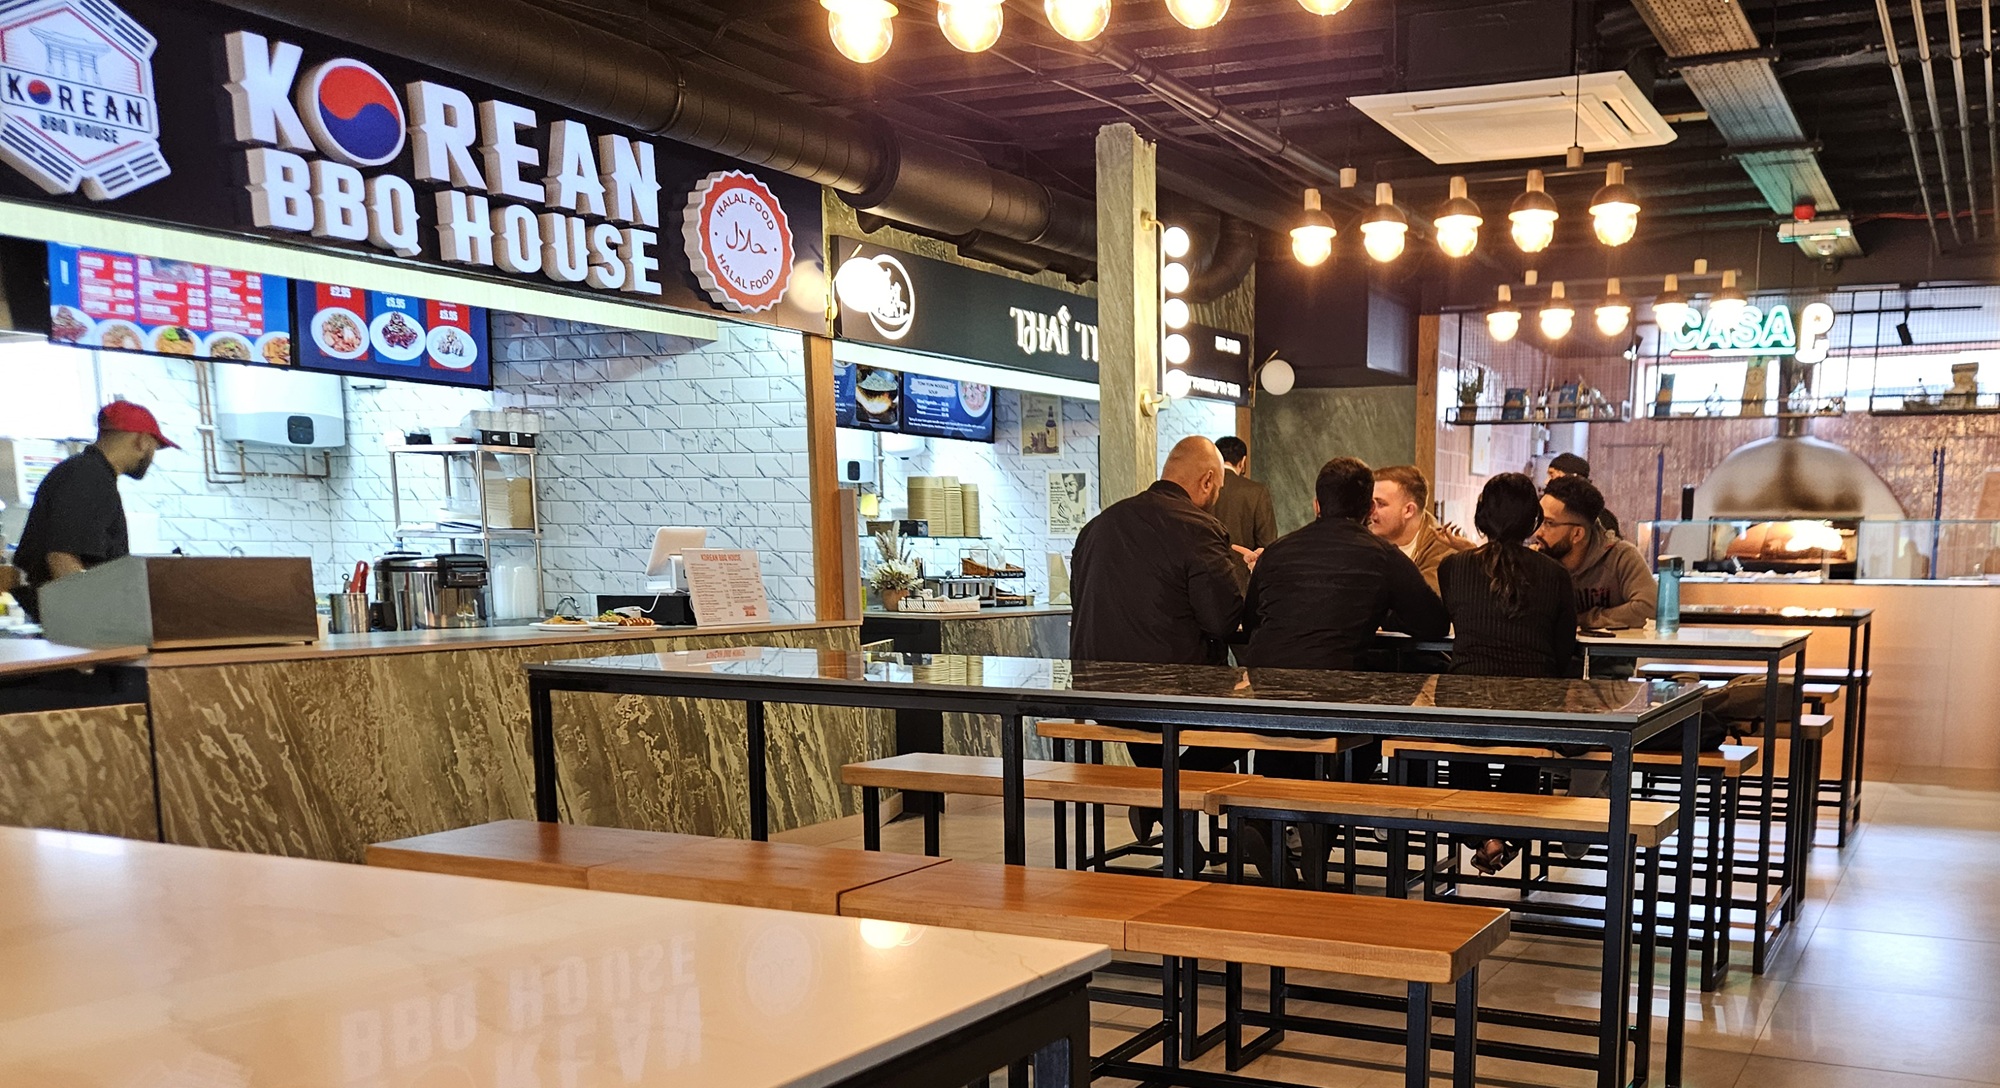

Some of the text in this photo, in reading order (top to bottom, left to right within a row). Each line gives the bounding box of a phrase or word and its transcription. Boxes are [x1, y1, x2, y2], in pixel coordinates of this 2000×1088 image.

[8, 73, 143, 127] KOREAN
[39, 114, 120, 145] BBQ HOUSE
[225, 30, 661, 228] KOREAN
[246, 148, 662, 295] BBQ HOUSE
[716, 193, 775, 231] HALAL FOOD
[725, 221, 767, 254] حلال
[717, 253, 775, 291] HALAL FOOD
[1669, 304, 1796, 351] CASA
